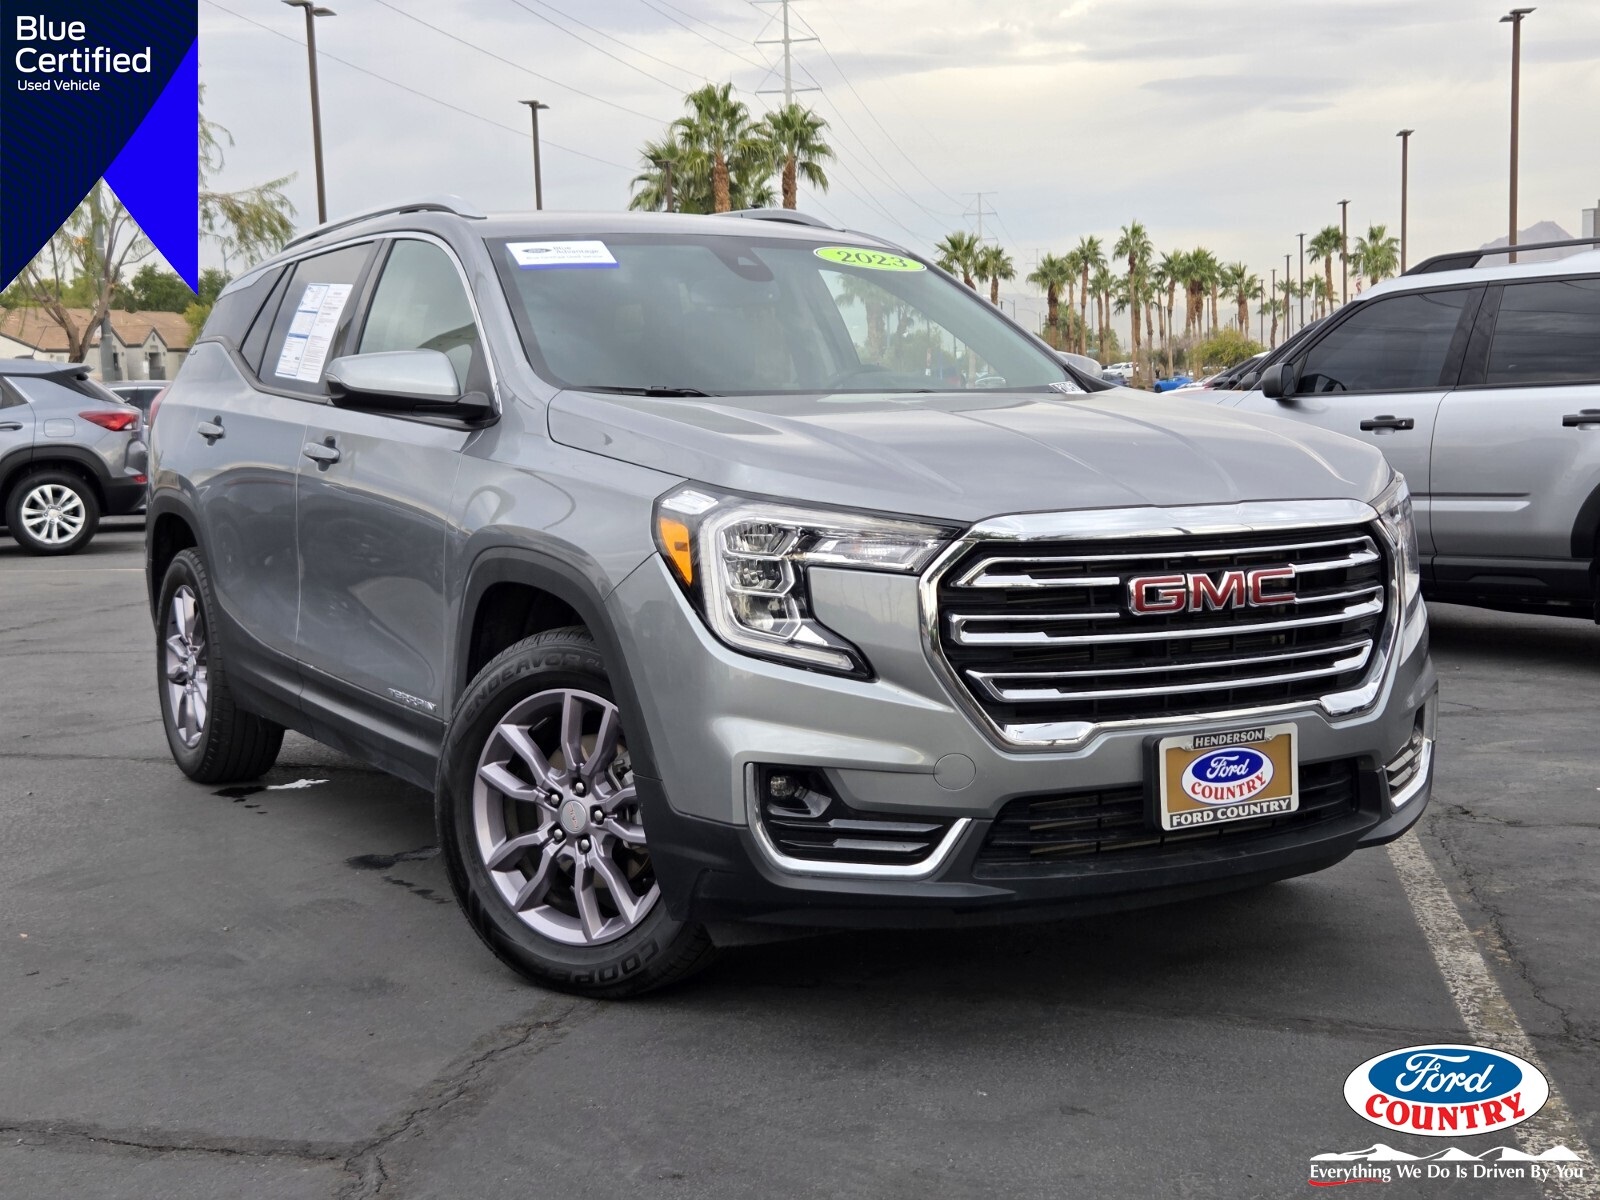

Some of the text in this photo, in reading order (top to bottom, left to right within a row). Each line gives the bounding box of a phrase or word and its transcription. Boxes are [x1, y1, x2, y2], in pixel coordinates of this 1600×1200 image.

[836, 250, 908, 267] 2023
[1128, 567, 1296, 616] GMC
[464, 652, 582, 722] ENDEAVOR
[1195, 729, 1264, 748] HENDERSON
[1206, 755, 1250, 779] Ford
[1190, 771, 1267, 800] COUNTRY
[1172, 798, 1290, 826] FORD COUNTRY
